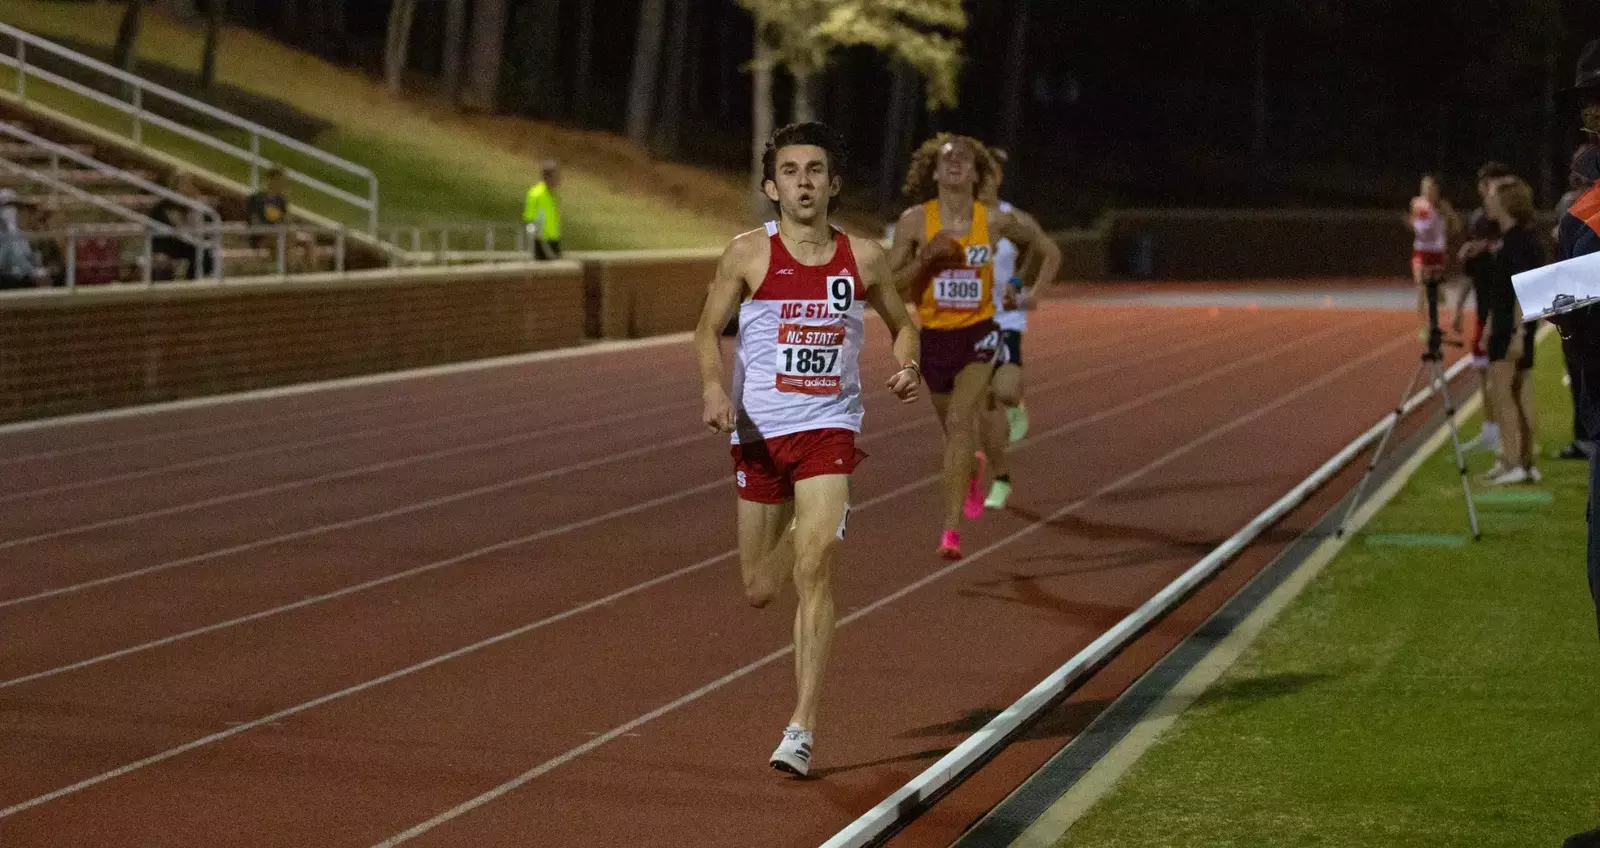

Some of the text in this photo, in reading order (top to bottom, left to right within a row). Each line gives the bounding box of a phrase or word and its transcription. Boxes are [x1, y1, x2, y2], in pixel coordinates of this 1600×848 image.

[969, 246, 988, 265] 22
[832, 278, 852, 311] 9
[939, 281, 978, 298] 1309
[781, 303, 802, 319] NC
[787, 331, 839, 344] NC STATE
[783, 348, 839, 373] 1857
[804, 378, 837, 387] adidas
